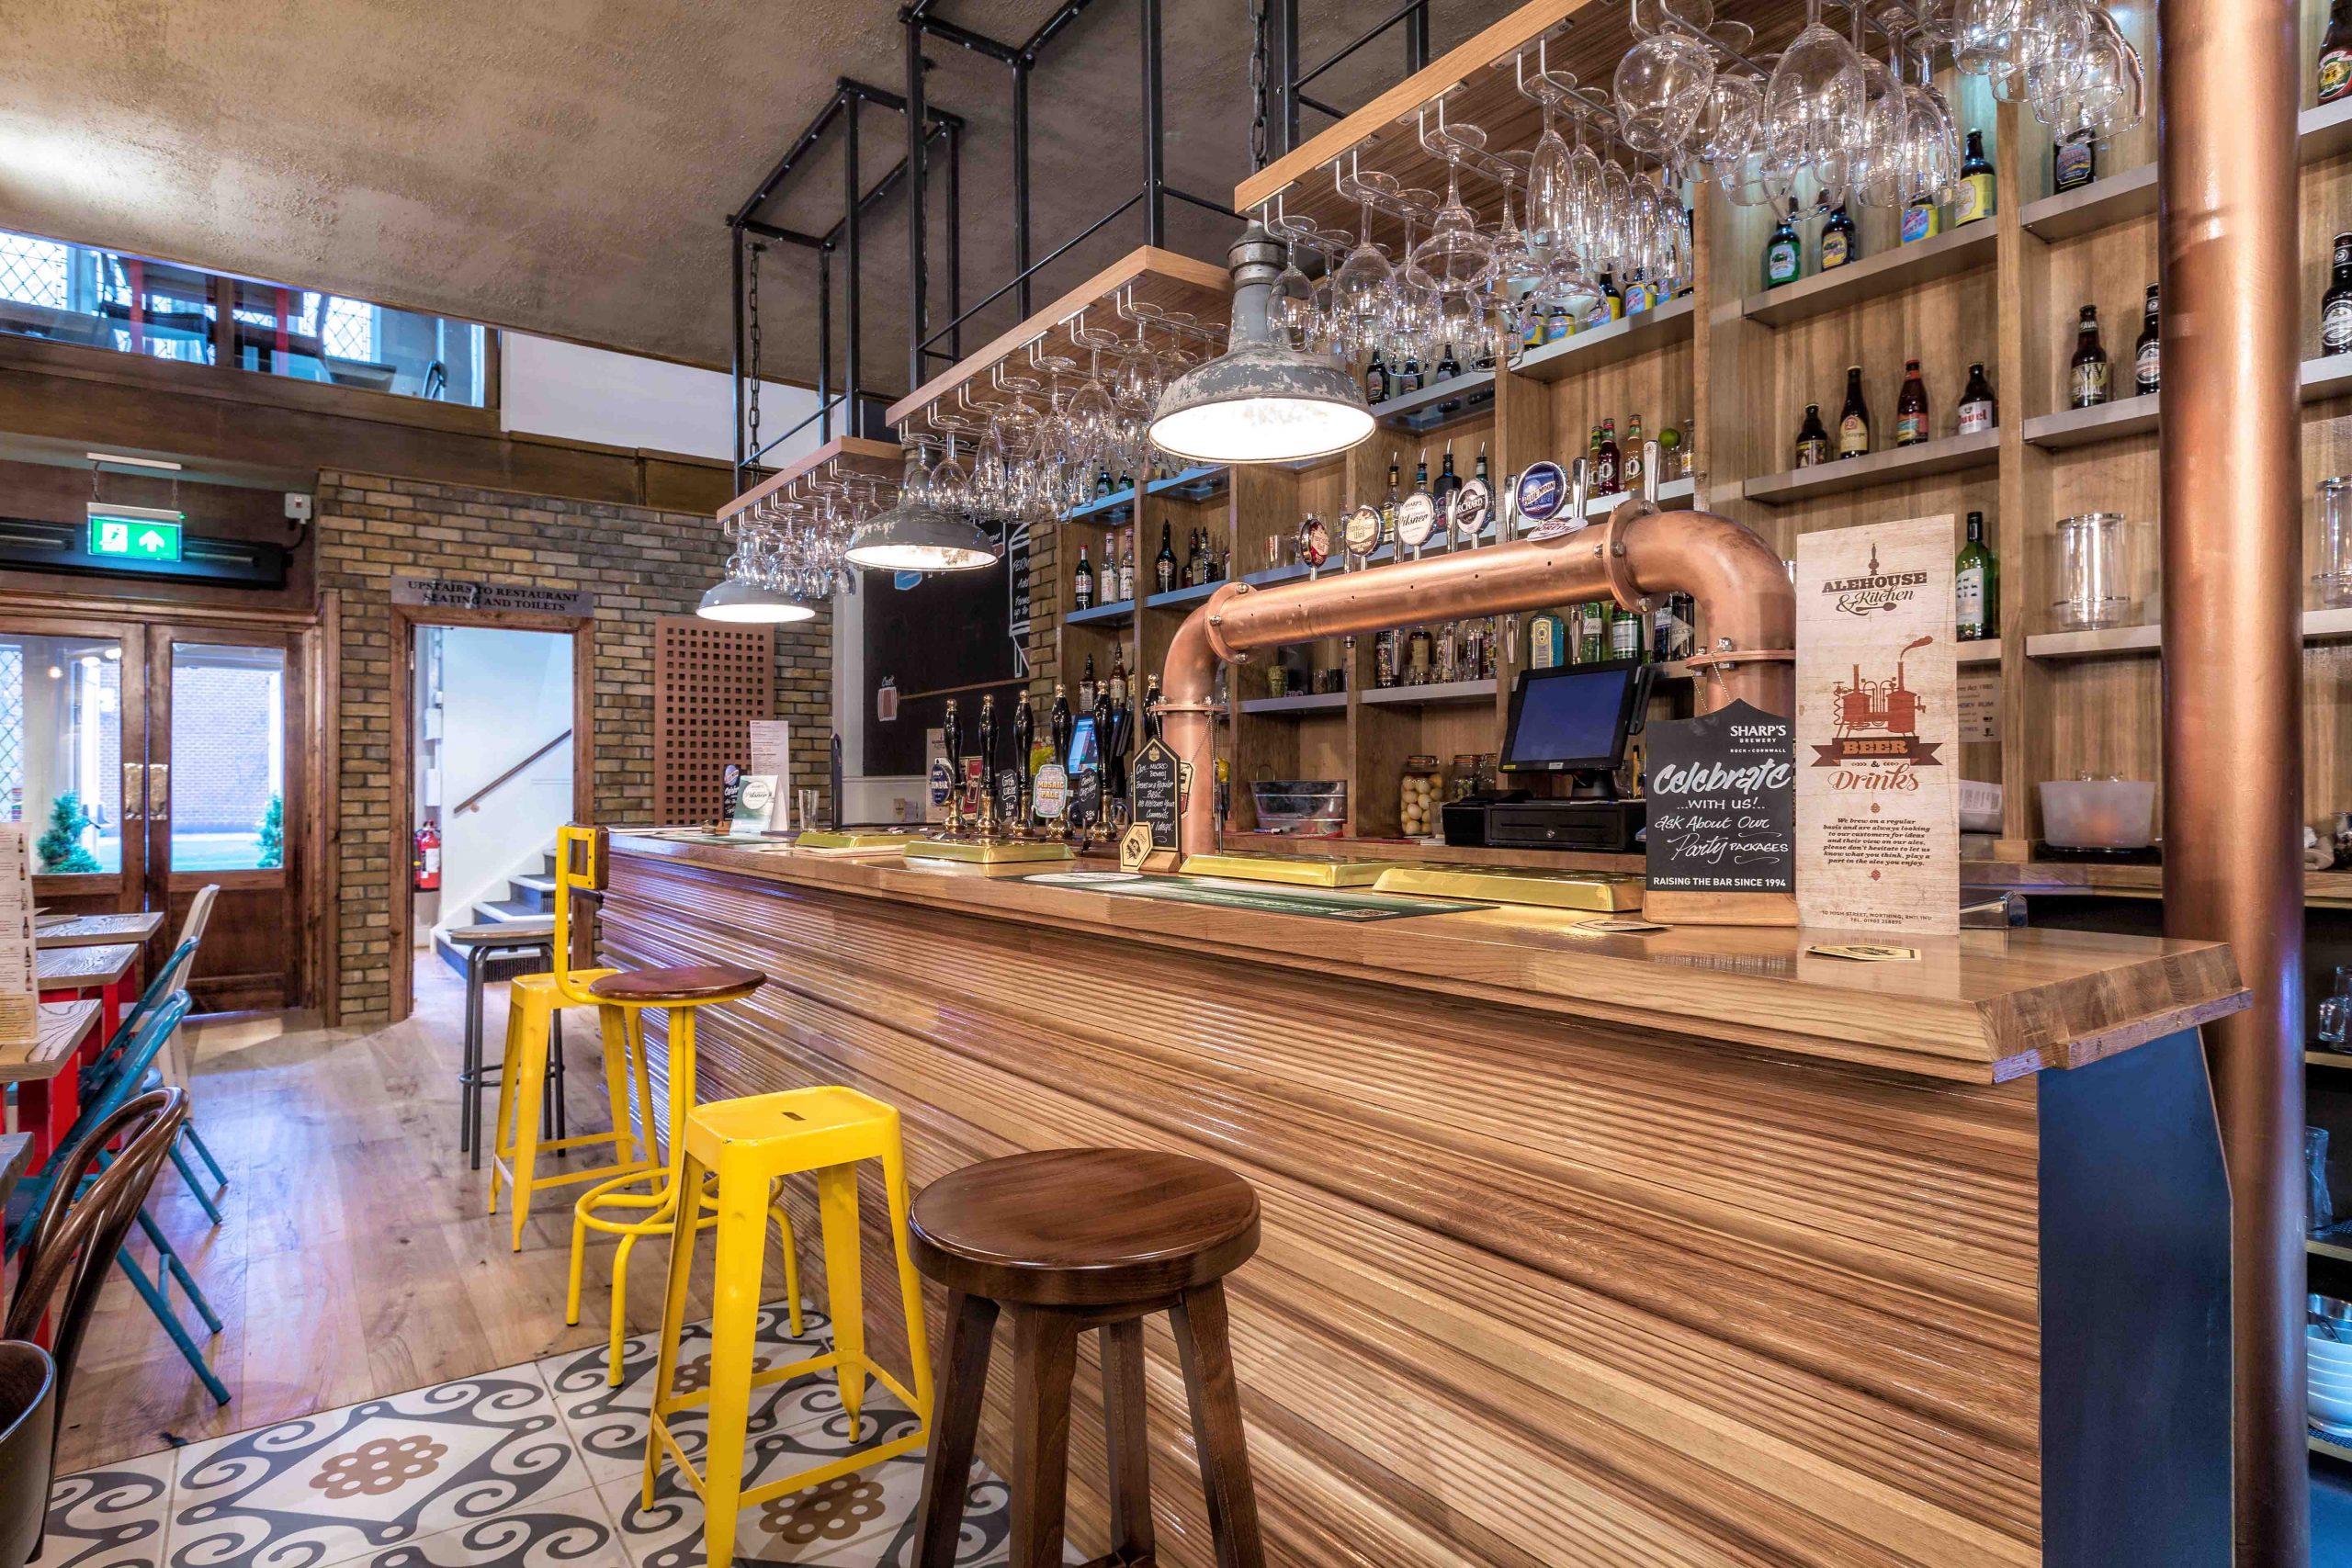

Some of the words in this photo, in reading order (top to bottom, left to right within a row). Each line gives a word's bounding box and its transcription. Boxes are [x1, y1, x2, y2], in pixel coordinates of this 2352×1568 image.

[1523, 492, 1538, 506] BLUE
[1538, 482, 1555, 496] MOON
[1457, 497, 1483, 513] RCHARD
[1399, 513, 1429, 527] Pilsner
[1821, 572, 1927, 593] ALEHOUSE
[408, 581, 471, 593] UPSTAIRS
[477, 584, 493, 595] TO
[496, 587, 580, 602] RESTAURANT
[1836, 594, 1870, 615] &
[1856, 584, 1915, 605] Kitchen
[424, 593, 481, 605] SEATING
[484, 598, 511, 608] AND
[515, 601, 566, 611] TOILETS
[1730, 725, 1786, 737] SHARP'S
[1842, 740, 1908, 755] BEER
[1654, 758, 1791, 795] Celebrate
[1827, 763, 1919, 791] Drinks
[1037, 781, 1065, 790] MOSAIC
[1040, 790, 1059, 799] PALE
[1686, 816, 1733, 831] About
[1737, 816, 1770, 829] Our
[1667, 832, 1729, 864] Party
[1729, 842, 1789, 852] PACKAGES
[1654, 877, 1690, 886] RAISING
[1713, 878, 1732, 886] BAR
[1734, 878, 1762, 886] SINCE
